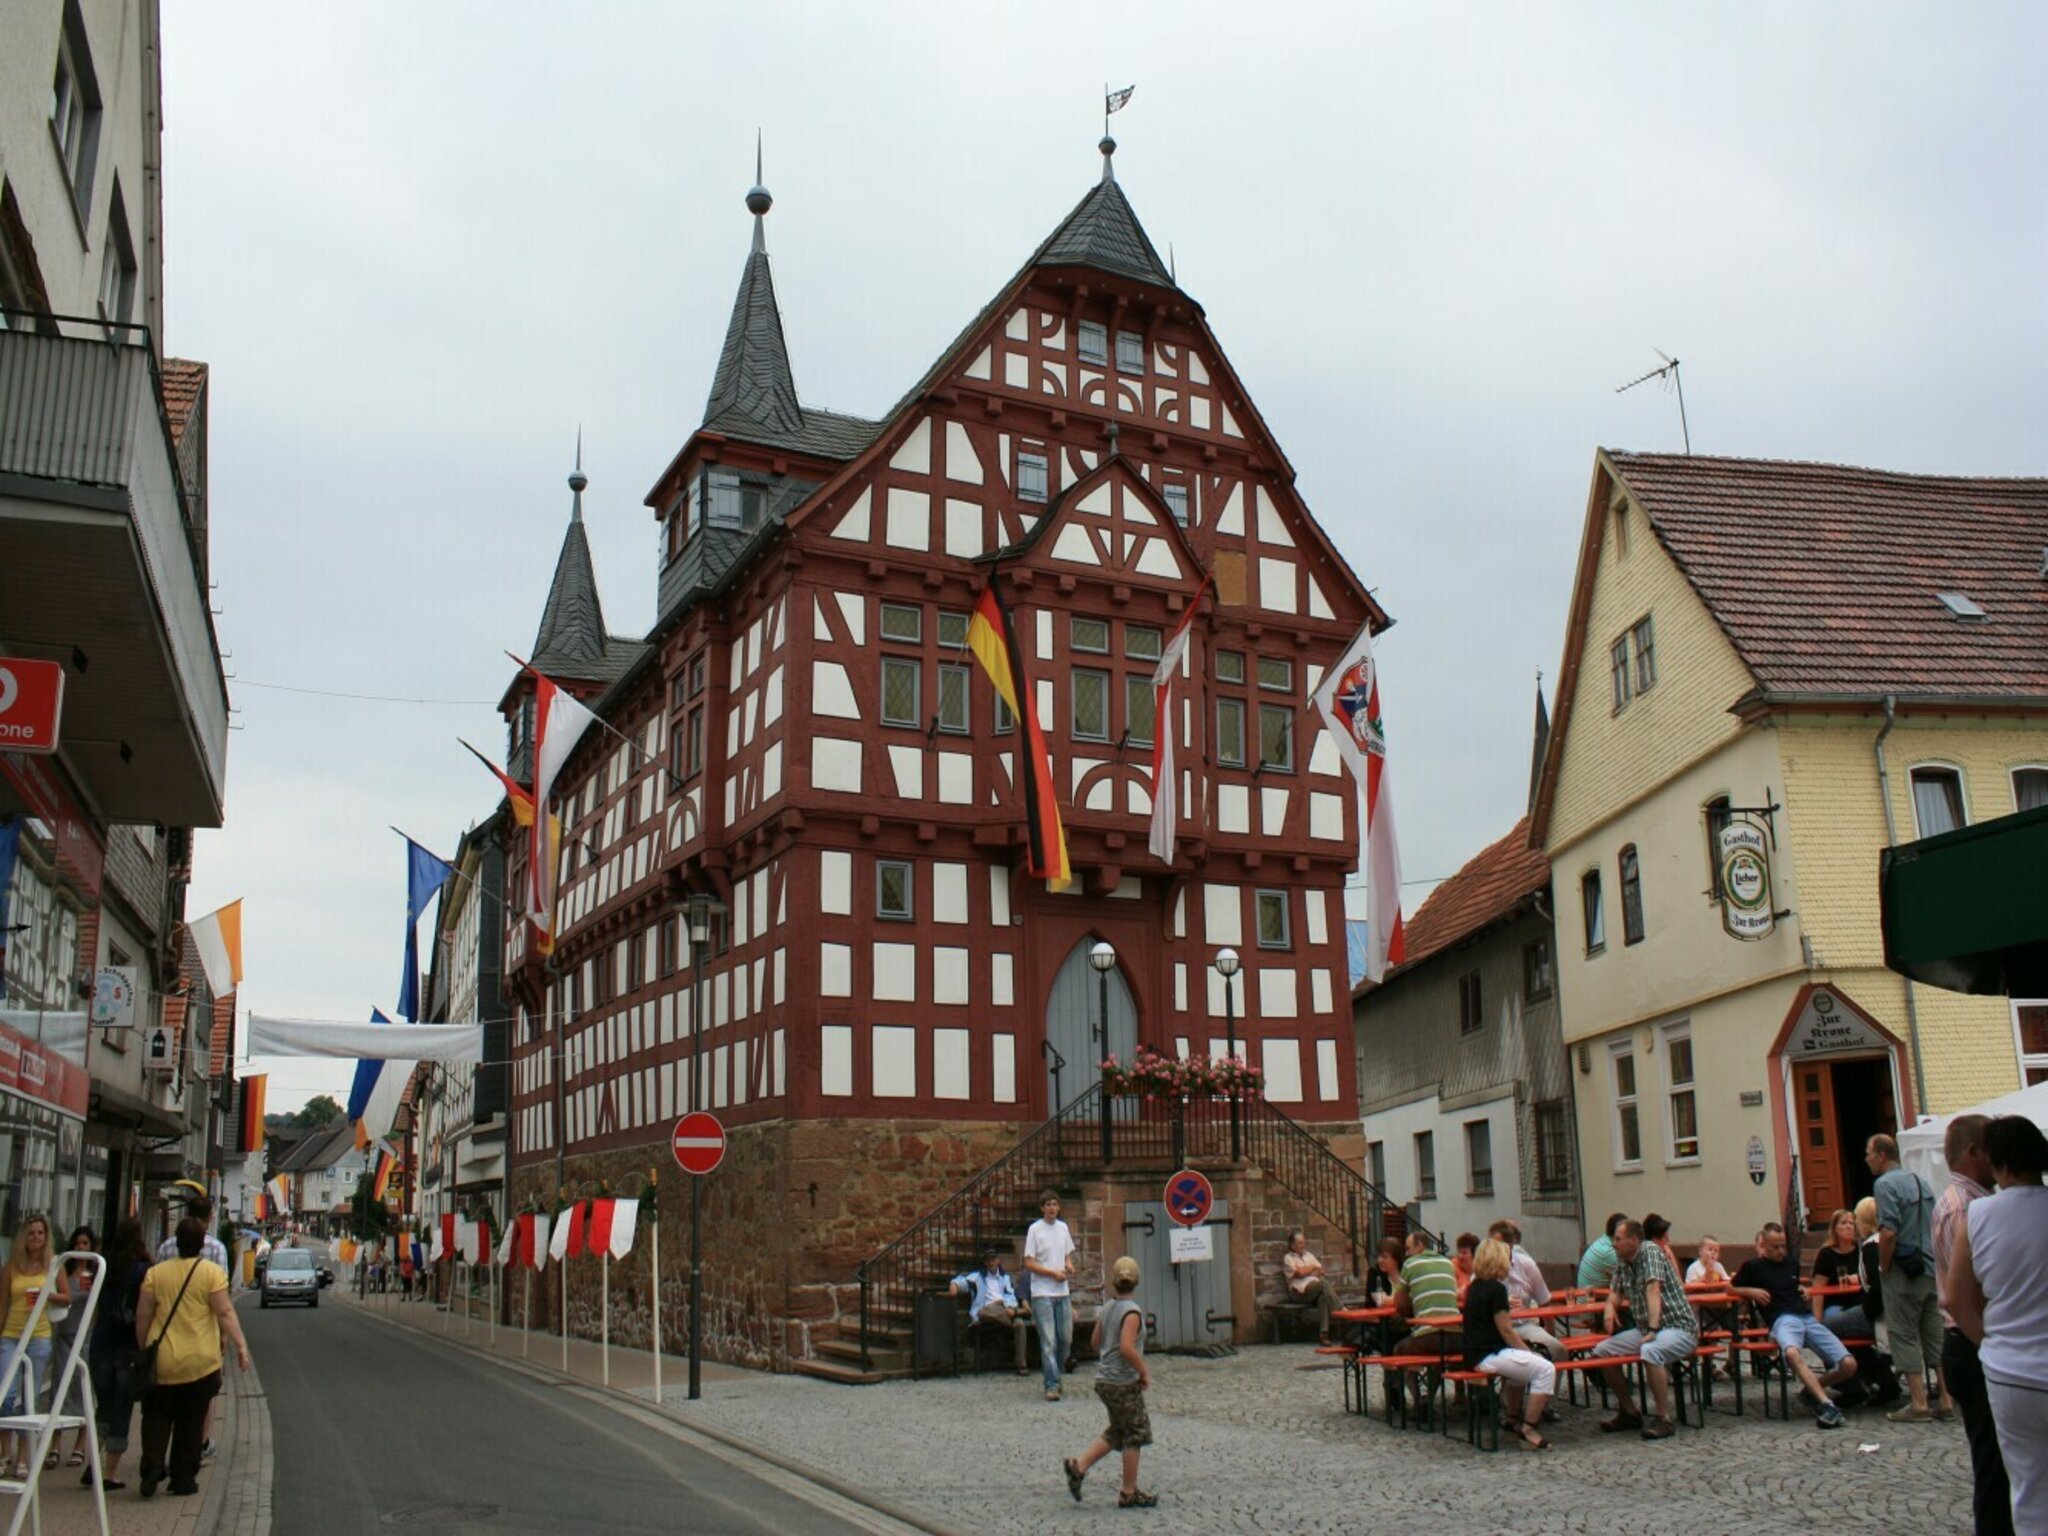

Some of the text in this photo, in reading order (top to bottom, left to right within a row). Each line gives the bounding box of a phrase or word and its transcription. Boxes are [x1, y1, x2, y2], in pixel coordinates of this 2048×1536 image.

[1724, 831, 1760, 847] Gasthof
[1735, 873, 1758, 886] Licher
[1816, 1015, 1841, 1027] Zur
[1811, 1027, 1851, 1037] Krone
[1819, 1037, 1864, 1048] Gasthof
